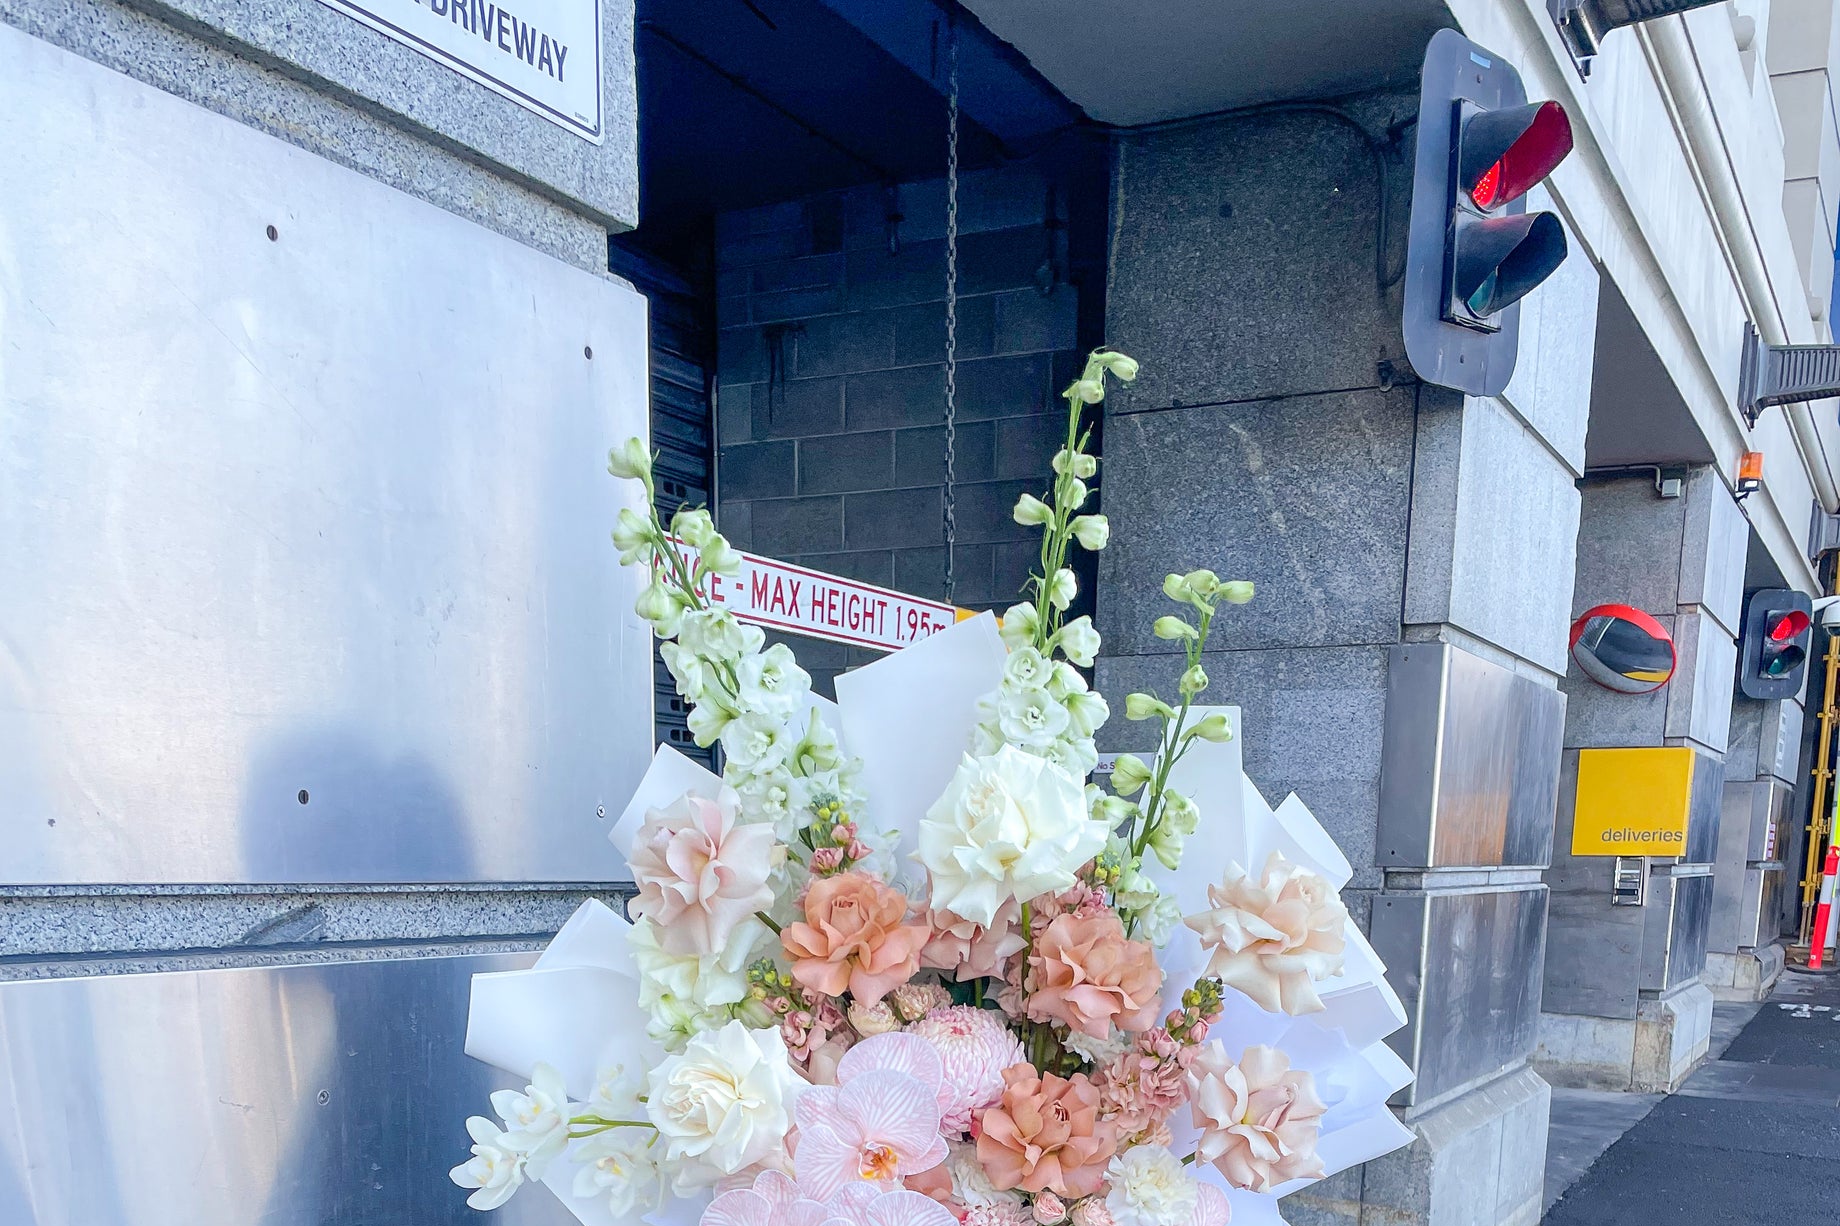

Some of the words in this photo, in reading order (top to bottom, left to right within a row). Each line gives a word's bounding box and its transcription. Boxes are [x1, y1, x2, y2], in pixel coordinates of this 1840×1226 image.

[751, 569, 801, 618] MAX
[811, 584, 887, 636] HEIGHT
[1601, 828, 1683, 842] deliveries
